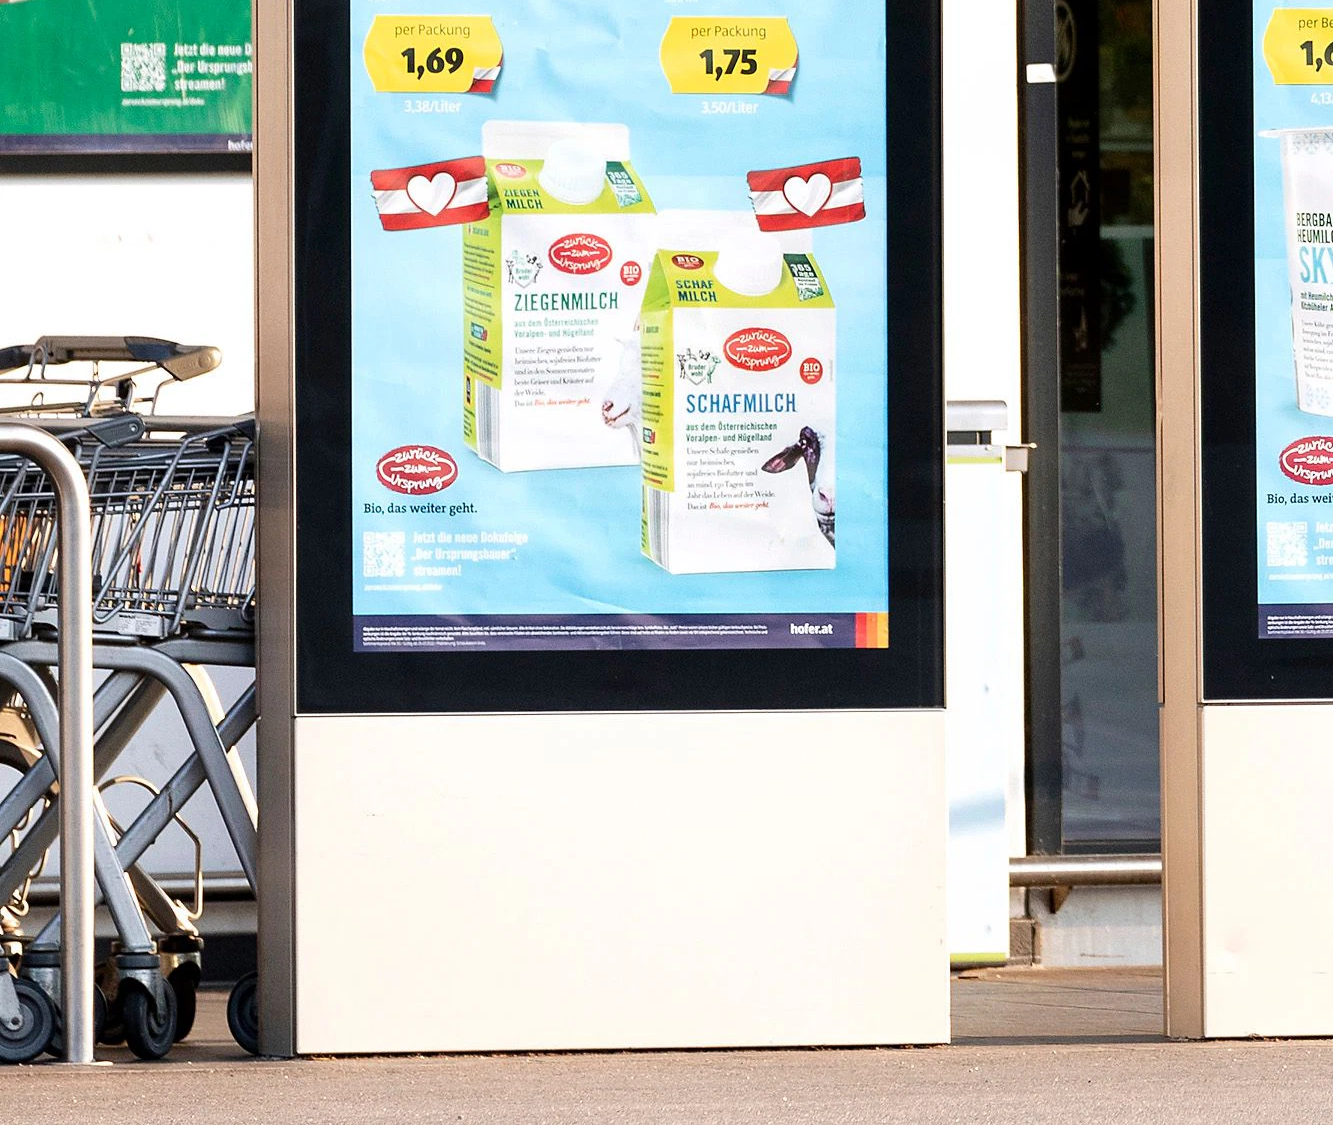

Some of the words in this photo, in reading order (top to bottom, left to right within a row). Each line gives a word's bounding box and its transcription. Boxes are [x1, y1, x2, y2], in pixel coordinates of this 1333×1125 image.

[394, 26, 415, 39] per
[418, 23, 471, 38] Packung
[691, 27, 711, 40] per
[714, 24, 767, 40] Packung
[1297, 19, 1318, 32] per
[400, 47, 464, 79] 1,69
[699, 49, 758, 80] 1,75
[403, 100, 461, 114] 3,38/Liter
[701, 100, 759, 115] 3,50/Liter
[506, 199, 543, 209] MILCH
[563, 236, 600, 248] zurück
[623, 266, 640, 275] BIO
[676, 279, 714, 289] SCHAF
[514, 292, 618, 311] ZIEGENMILCH
[678, 291, 717, 302] MILCH
[739, 331, 776, 344] zurück
[747, 345, 768, 353] zum
[736, 354, 779, 370] Ursprung
[803, 363, 820, 372] BIO
[686, 393, 797, 413] SCHAFMILCH
[701, 423, 716, 431] dem
[723, 433, 736, 442] und
[394, 448, 439, 464] zurück
[1306, 455, 1331, 464] zum
[403, 464, 430, 473] zum
[389, 474, 443, 493] Ursprung
[1267, 493, 1287, 505] Bio,
[1290, 493, 1309, 504] das
[363, 503, 385, 515] Bio,
[387, 502, 407, 514] das
[410, 502, 447, 514] weiter
[449, 502, 478, 517] geht.
[790, 623, 833, 637] hofer.at
